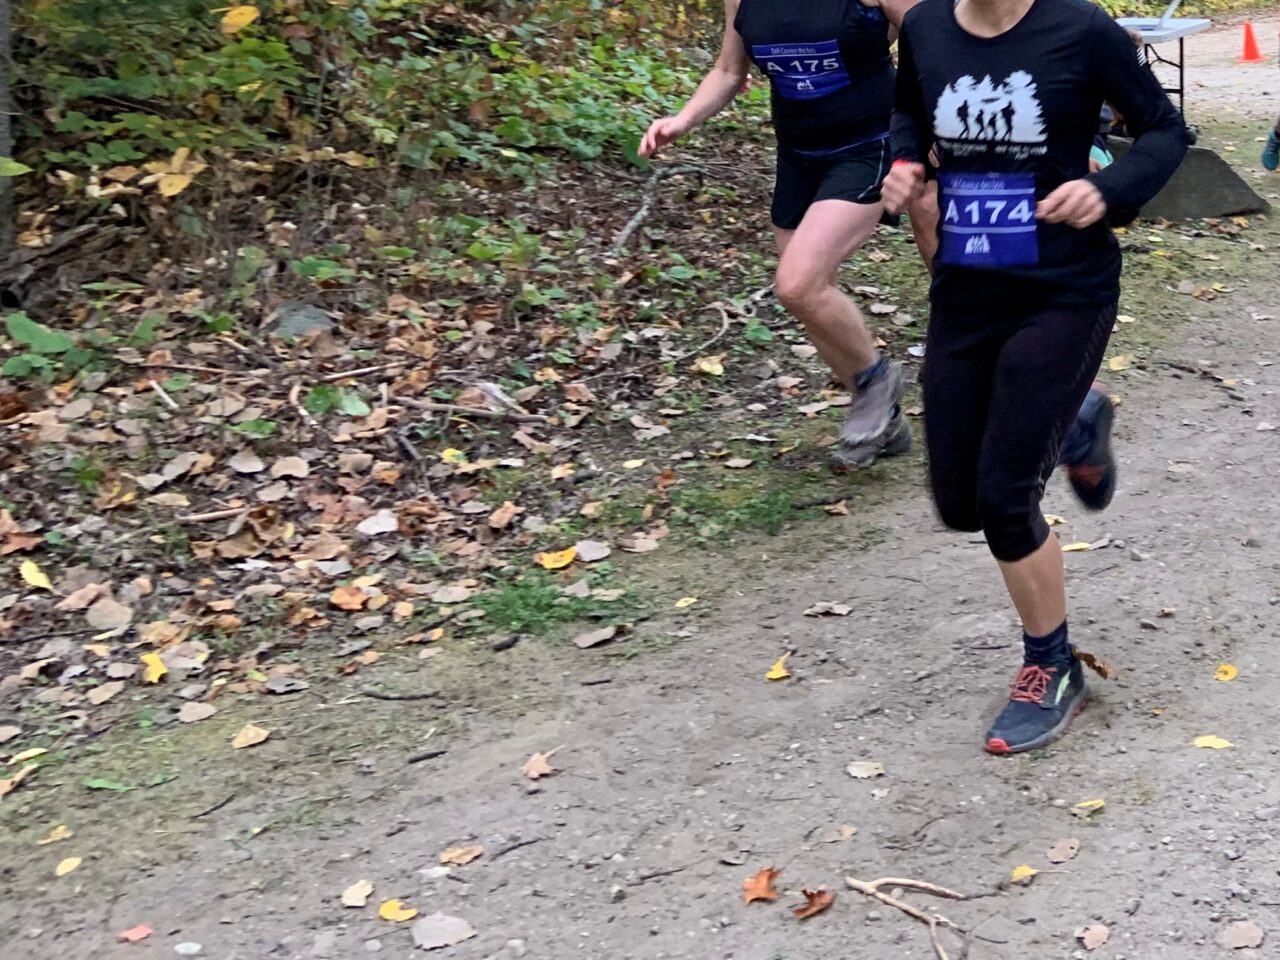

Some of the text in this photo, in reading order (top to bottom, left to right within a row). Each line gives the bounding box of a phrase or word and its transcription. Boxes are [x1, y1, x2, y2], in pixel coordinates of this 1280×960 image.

[767, 58, 839, 72] A 175
[945, 199, 1033, 224] A 174
